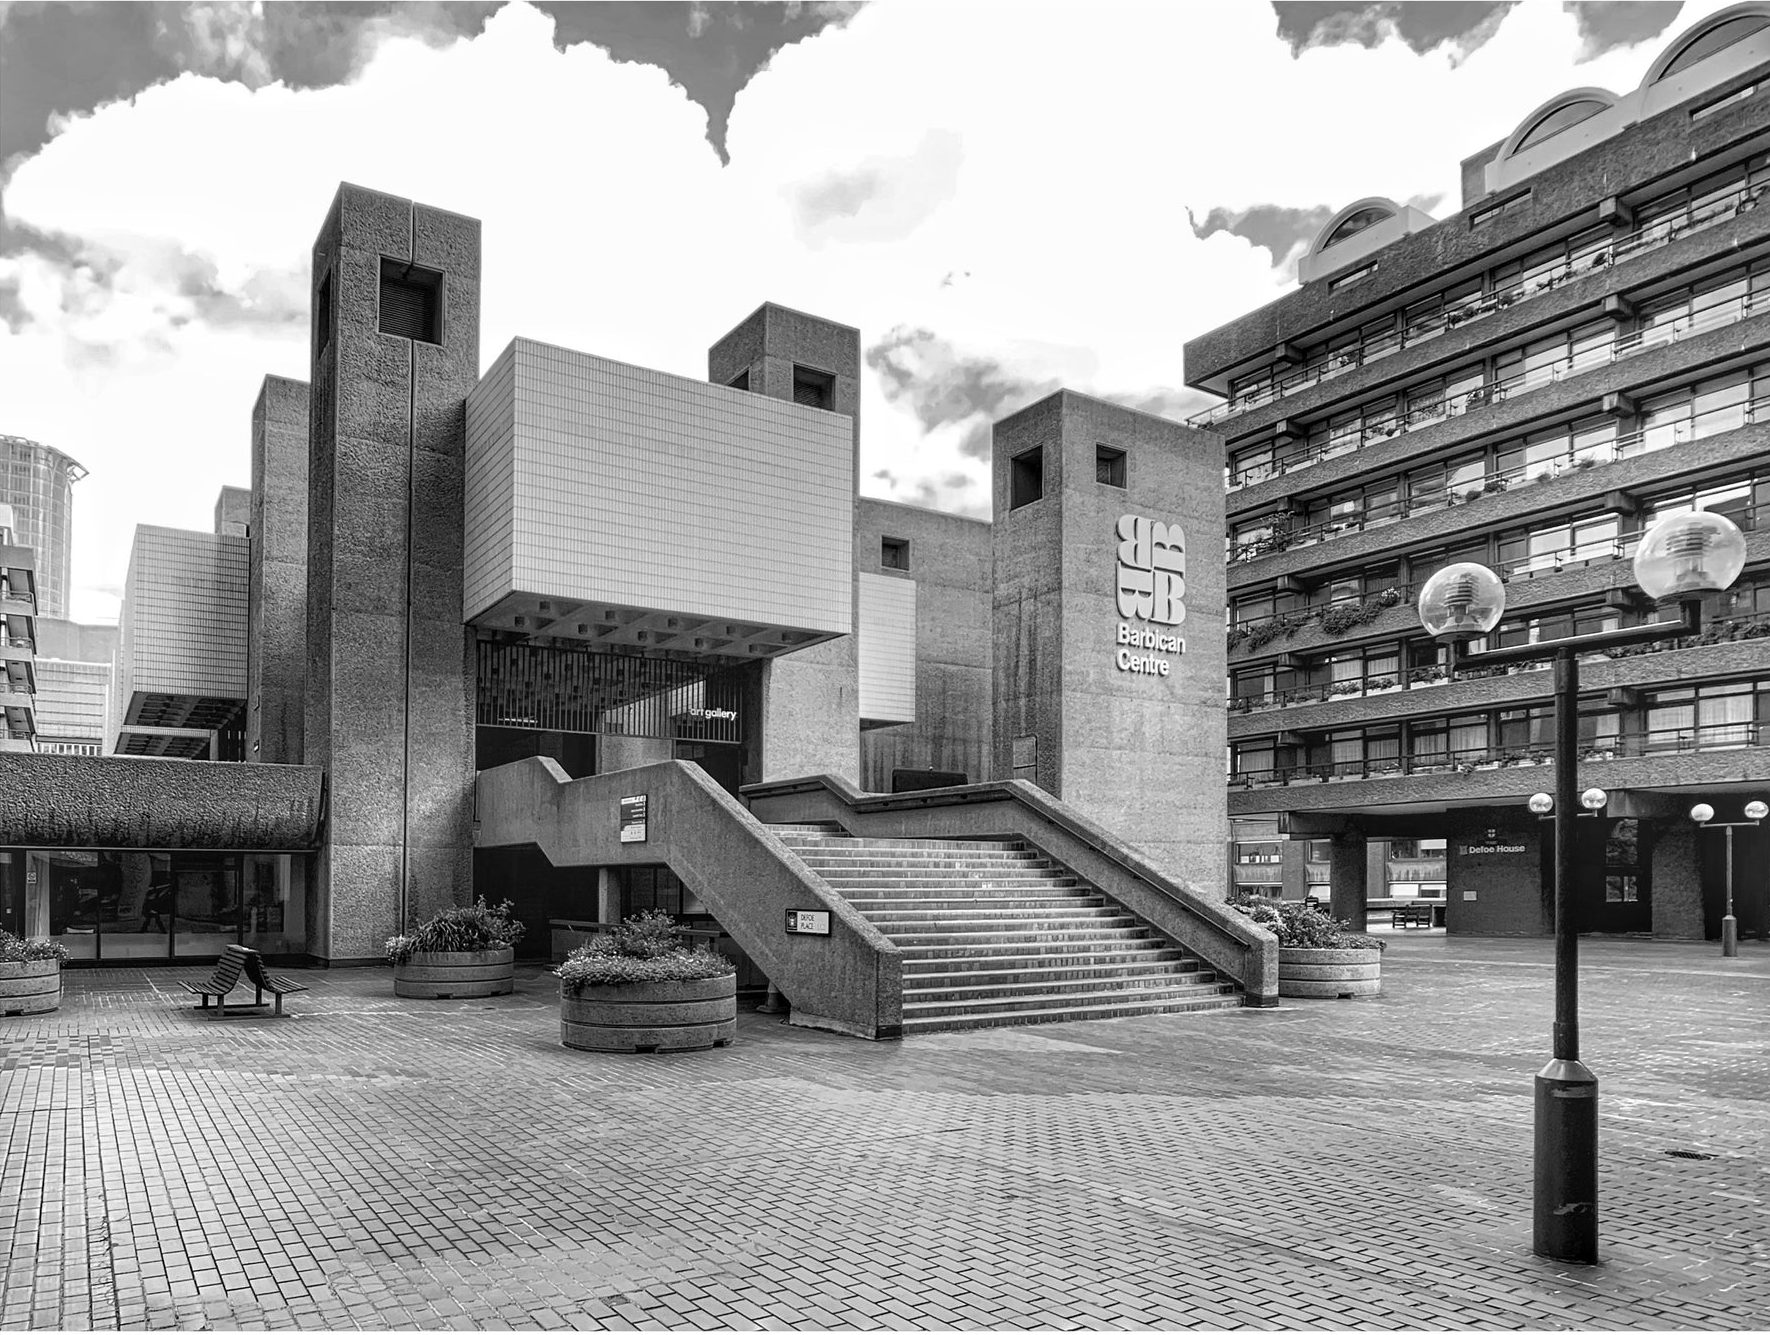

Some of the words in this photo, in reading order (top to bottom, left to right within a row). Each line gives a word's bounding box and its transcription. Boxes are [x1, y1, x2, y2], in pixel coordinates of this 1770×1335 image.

[1117, 622, 1186, 654] Barbican
[1117, 649, 1170, 676] Centre
[690, 708, 704, 717] art
[705, 707, 737, 721] gallery
[1469, 846, 1495, 854] Defoe
[1496, 845, 1526, 854] House
[800, 922, 814, 930] PLACE
